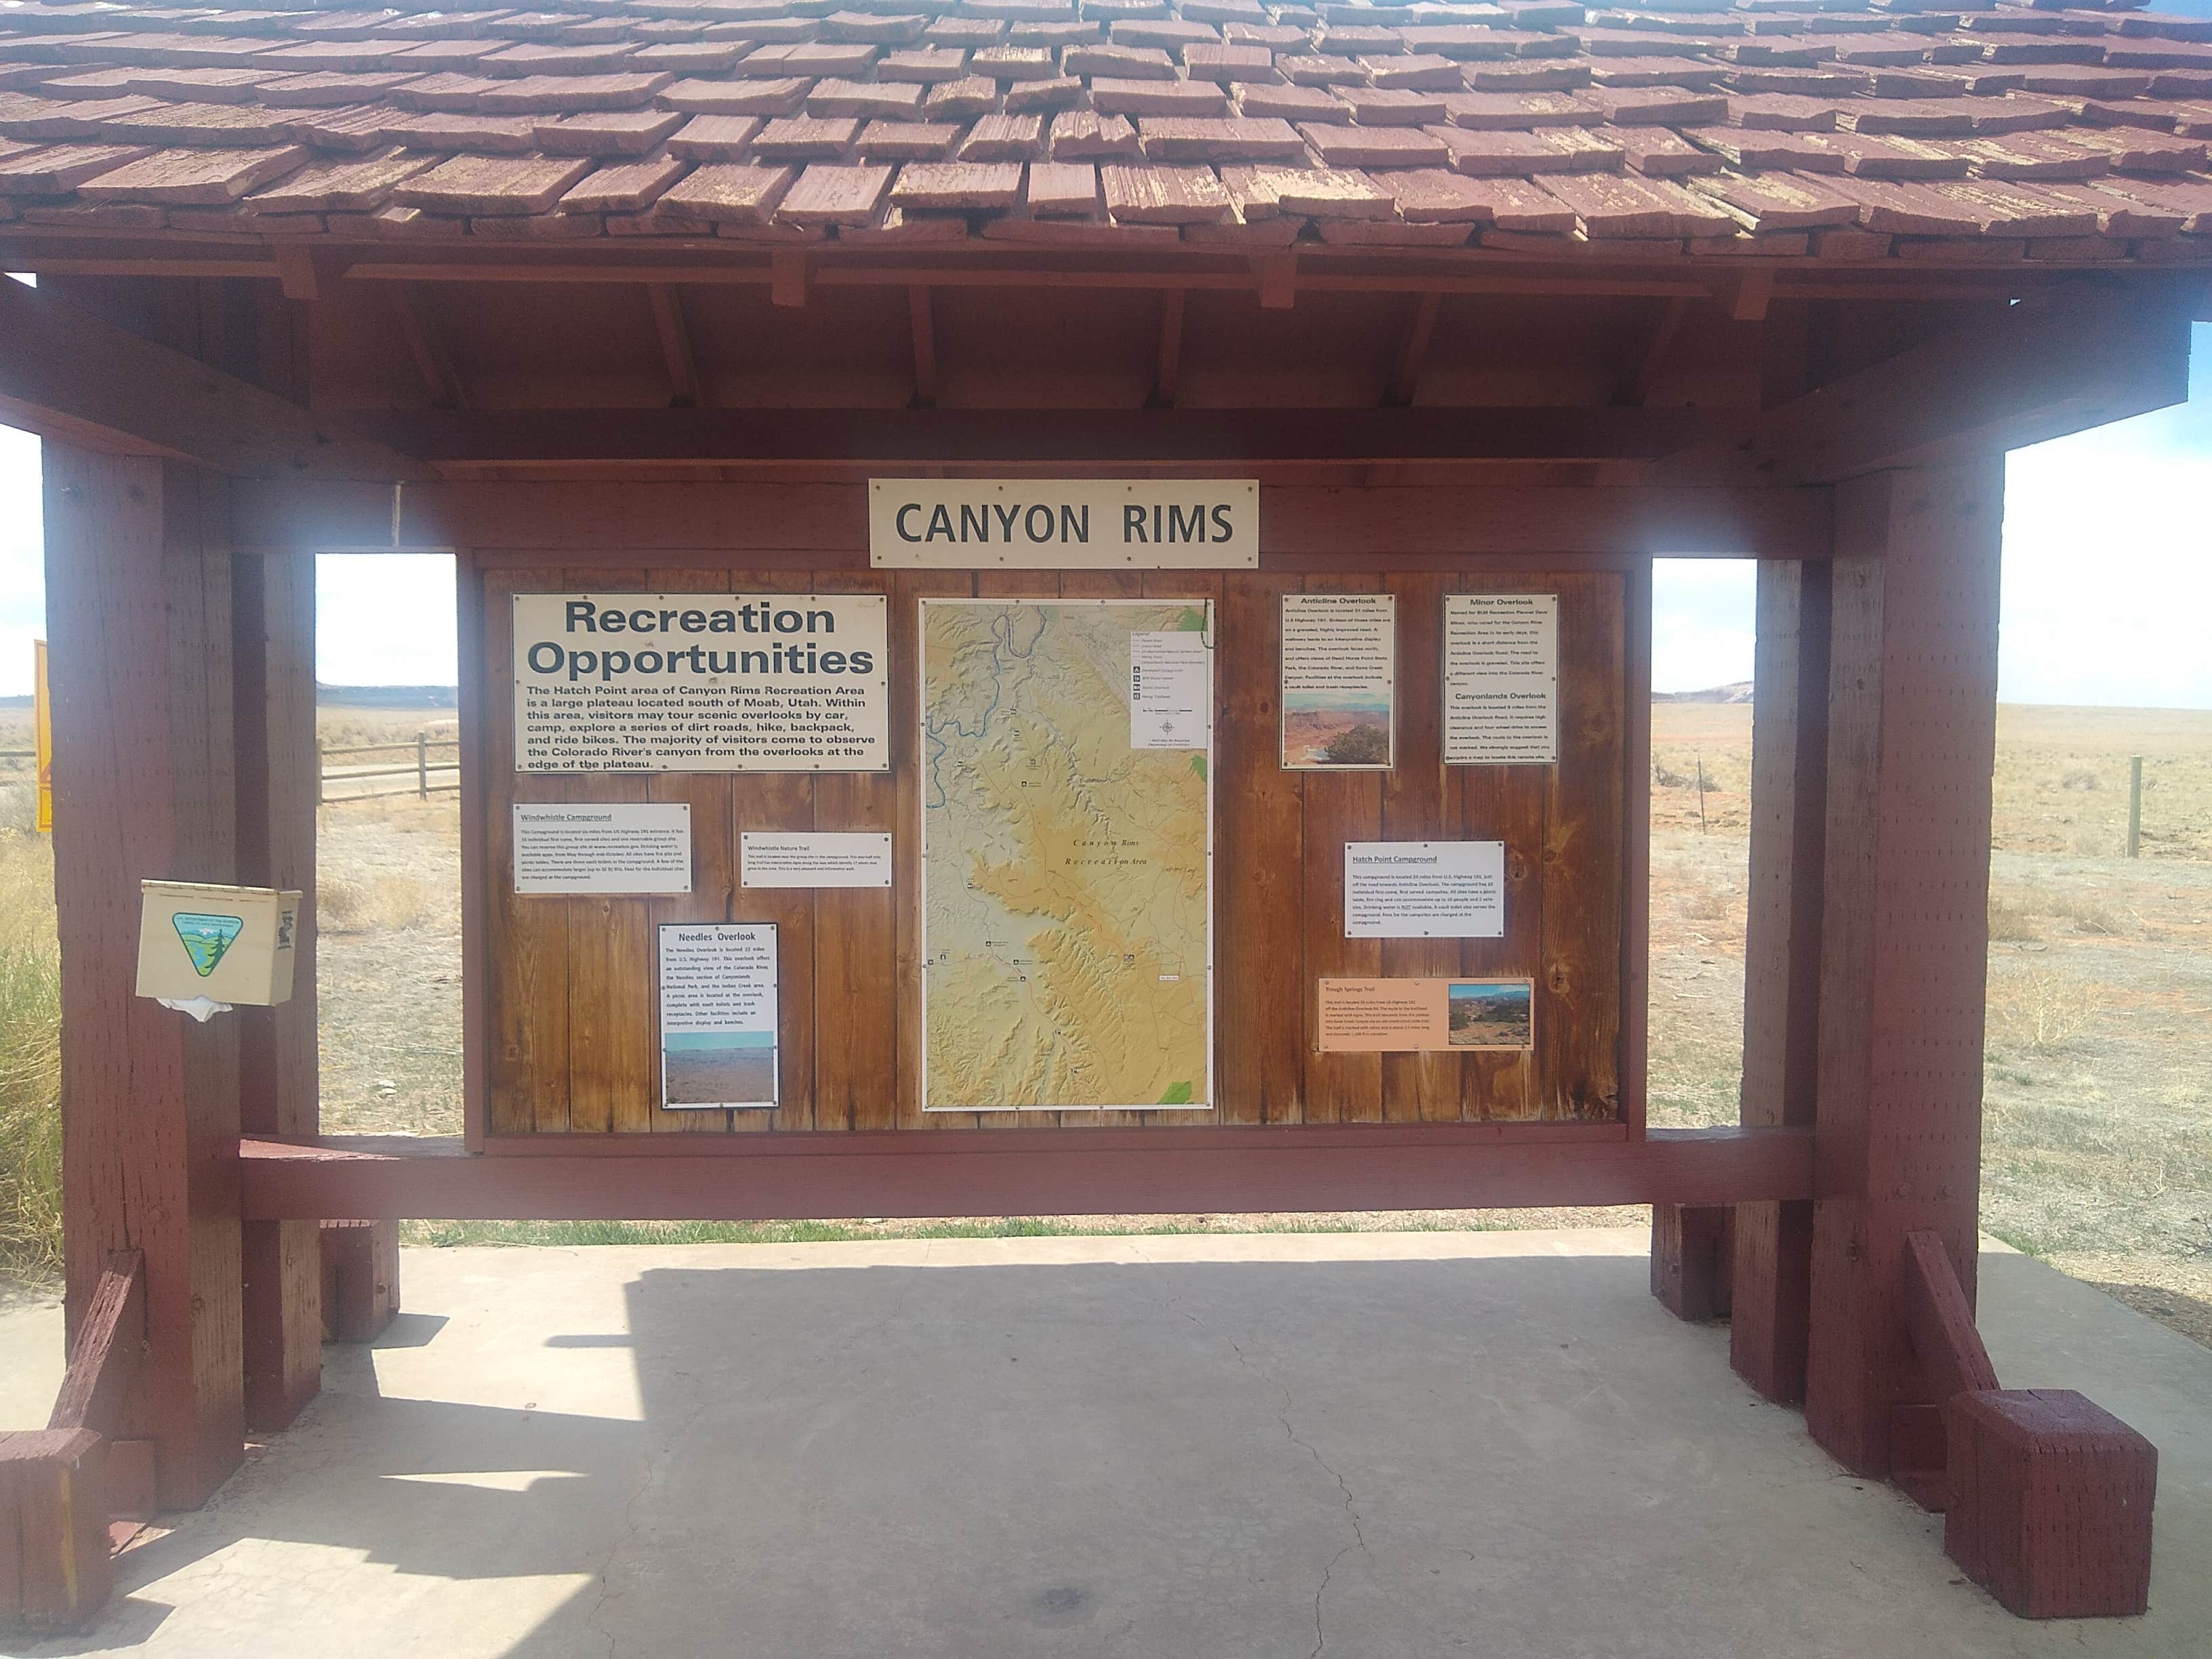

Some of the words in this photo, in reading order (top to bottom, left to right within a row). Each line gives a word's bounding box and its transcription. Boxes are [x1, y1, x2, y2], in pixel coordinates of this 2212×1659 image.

[896, 503, 1088, 543] CANYON
[1124, 504, 1232, 543] RIMS
[566, 601, 834, 633] Recreation
[528, 641, 874, 682] Opportunities
[527, 686, 550, 694] The
[554, 686, 590, 694] Hatch
[595, 686, 627, 694] Point
[662, 686, 675, 694] of
[679, 686, 726, 696] Canyon
[731, 686, 760, 694] Rims
[764, 686, 831, 695] Recreation
[836, 686, 864, 695] Area
[527, 699, 536, 707] is
[552, 699, 583, 708] large
[587, 698, 633, 708] plateau
[638, 698, 683, 707] located
[727, 698, 740, 707] of
[744, 698, 783, 708] Moab,
[788, 698, 821, 707] Utah.
[825, 698, 865, 707] Within
[527, 711, 549, 719] this
[588, 710, 633, 719] visitors
[638, 712, 663, 720] may
[698, 710, 737, 719] scenic
[741, 710, 802, 719] overlooks
[806, 710, 821, 721] by
[527, 725, 565, 733] camp,
[569, 723, 615, 733] explore
[631, 722, 667, 731] series
[671, 722, 683, 731] of
[688, 722, 709, 731] dirt
[714, 722, 752, 732] roads,
[756, 722, 785, 732] hike,
[790, 722, 854, 733] backpack,
[527, 735, 550, 743] and
[554, 735, 578, 743] ride
[582, 735, 618, 743] bikes.
[623, 735, 646, 743] The
[651, 735, 701, 745] majority
[705, 735, 718, 743] of
[722, 735, 767, 743] visitors
[826, 735, 875, 743] observe
[528, 747, 548, 756] the
[552, 747, 607, 756] Colorado
[612, 747, 651, 756] River's
[655, 750, 701, 758] canyon
[705, 747, 735, 756] from
[739, 747, 759, 756] the
[763, 747, 823, 756] overlooks
[827, 747, 840, 756] at
[844, 747, 863, 755] the
[528, 760, 558, 770] edge
[562, 760, 575, 768] of
[603, 760, 653, 770] plateau.
[1073, 839, 1117, 847] Canyon
[678, 933, 712, 941] Needles
[717, 932, 755, 941] Overlook
